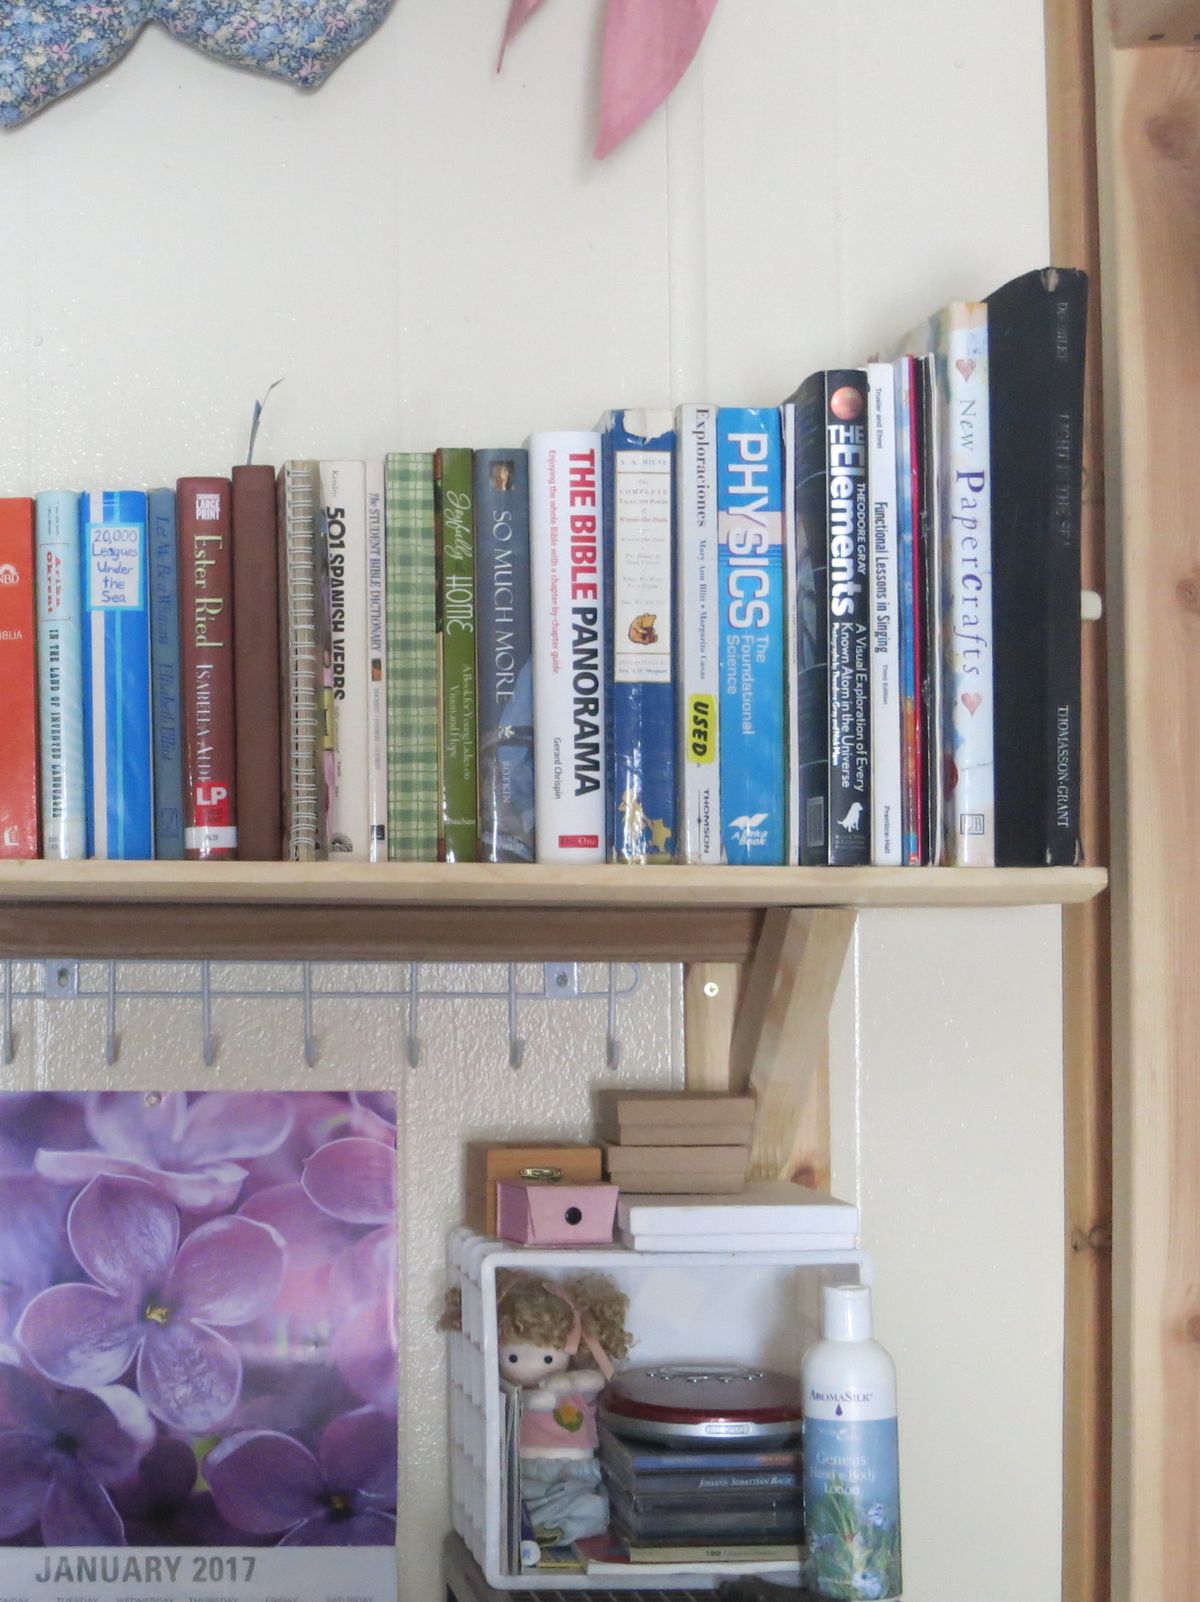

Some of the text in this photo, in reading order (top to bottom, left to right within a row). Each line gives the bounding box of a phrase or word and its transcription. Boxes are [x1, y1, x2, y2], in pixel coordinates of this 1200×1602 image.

[827, 425, 865, 445] THE
[959, 400, 977, 452] New
[692, 408, 711, 528] Exploraciones
[155, 515, 170, 538] Let
[196, 500, 220, 510] LARGE
[196, 510, 220, 521] PRINT
[326, 506, 346, 550] 501
[726, 432, 770, 629] PHYSICS
[830, 445, 865, 617] Elements
[855, 482, 868, 575] THEODORE GRAY
[94, 529, 138, 545] 20,000
[97, 561, 134, 575] Under
[193, 534, 223, 589] Ester
[443, 490, 474, 636] Joyfully HOME
[546, 450, 561, 675] Enjoying the whole Bible with chapter-by-chapter guide
[46, 551, 55, 614] Okrent
[100, 589, 127, 603] Sea
[102, 575, 126, 589] the
[329, 554, 346, 632] SPANISH
[368, 492, 382, 652] The STUDENT BIBLE DICTIONARY
[874, 501, 890, 654] Functional Lessons in Singing
[194, 597, 224, 647] Ried
[492, 510, 515, 705] SO MUCH MORE
[568, 449, 601, 797] THE BIBLE PANORAMA
[331, 638, 346, 701] VERBS
[726, 634, 739, 695] Science
[756, 634, 770, 664] The
[195, 664, 214, 737] ISABELLA
[741, 634, 755, 736] Foundational
[840, 622, 856, 788] Known Atom in the Universe
[854, 622, 869, 793] A Visual Exploration of Every
[49, 629, 63, 819] IN THE LAND OF INVENTED LANGUAGES
[159, 724, 176, 762] Elliot
[691, 700, 709, 757] USED
[196, 786, 228, 806] LP
[551, 737, 563, 800] Gerard Chrispin
[703, 789, 711, 854] THOMSON
[883, 805, 891, 854] Prentice-Hall
[699, 1478, 729, 1489] JOHANN
[771, 1476, 793, 1486] BACH
[34, 1555, 257, 1584] JANUARY 2017
